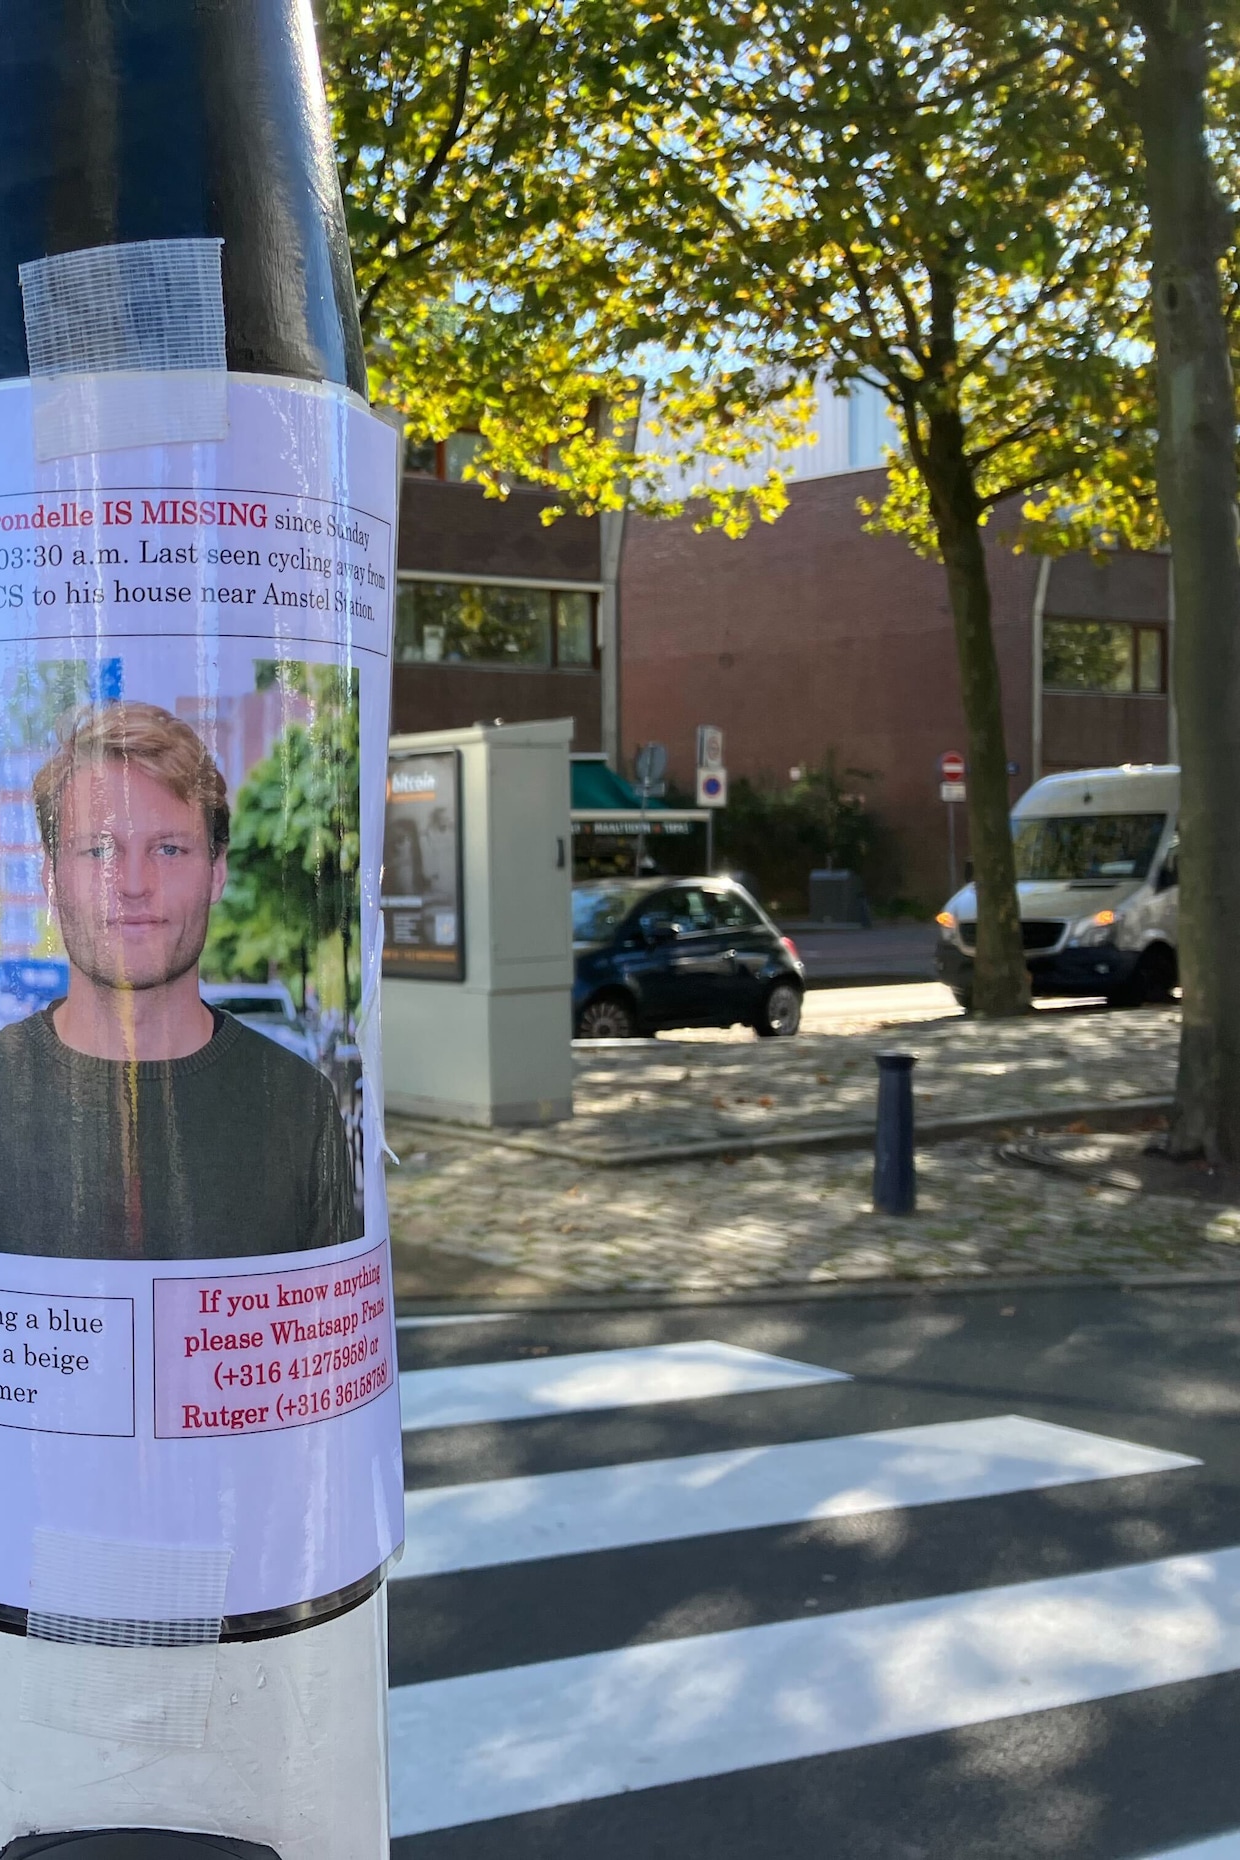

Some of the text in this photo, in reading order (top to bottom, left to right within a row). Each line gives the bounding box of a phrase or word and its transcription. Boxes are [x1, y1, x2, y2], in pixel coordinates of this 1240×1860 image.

[102, 501, 133, 526] IS
[140, 500, 268, 528] MISSING
[275, 508, 322, 535] since
[326, 515, 370, 551] Sunday
[72, 548, 129, 566] a.m.
[138, 540, 198, 564] Last
[207, 548, 261, 566] seen
[268, 547, 332, 578] cycling
[336, 560, 366, 587] away
[367, 563, 386, 590] from
[32, 585, 57, 606] to
[65, 581, 105, 605] his
[113, 580, 191, 603] house
[201, 586, 256, 604] near
[262, 582, 331, 611] Amstel
[334, 590, 375, 621] Station.
[199, 1263, 381, 1317] If you know anything
[26, 1313, 39, 1329] a
[47, 1307, 103, 1333] blue
[184, 1297, 385, 1358] please Whatsapp Frans
[3, 1348, 16, 1364] a
[23, 1343, 90, 1375] beige
[214, 1335, 379, 1391] (+316 41275958) or
[181, 1357, 388, 1430] Rutger (+316 36158758)
